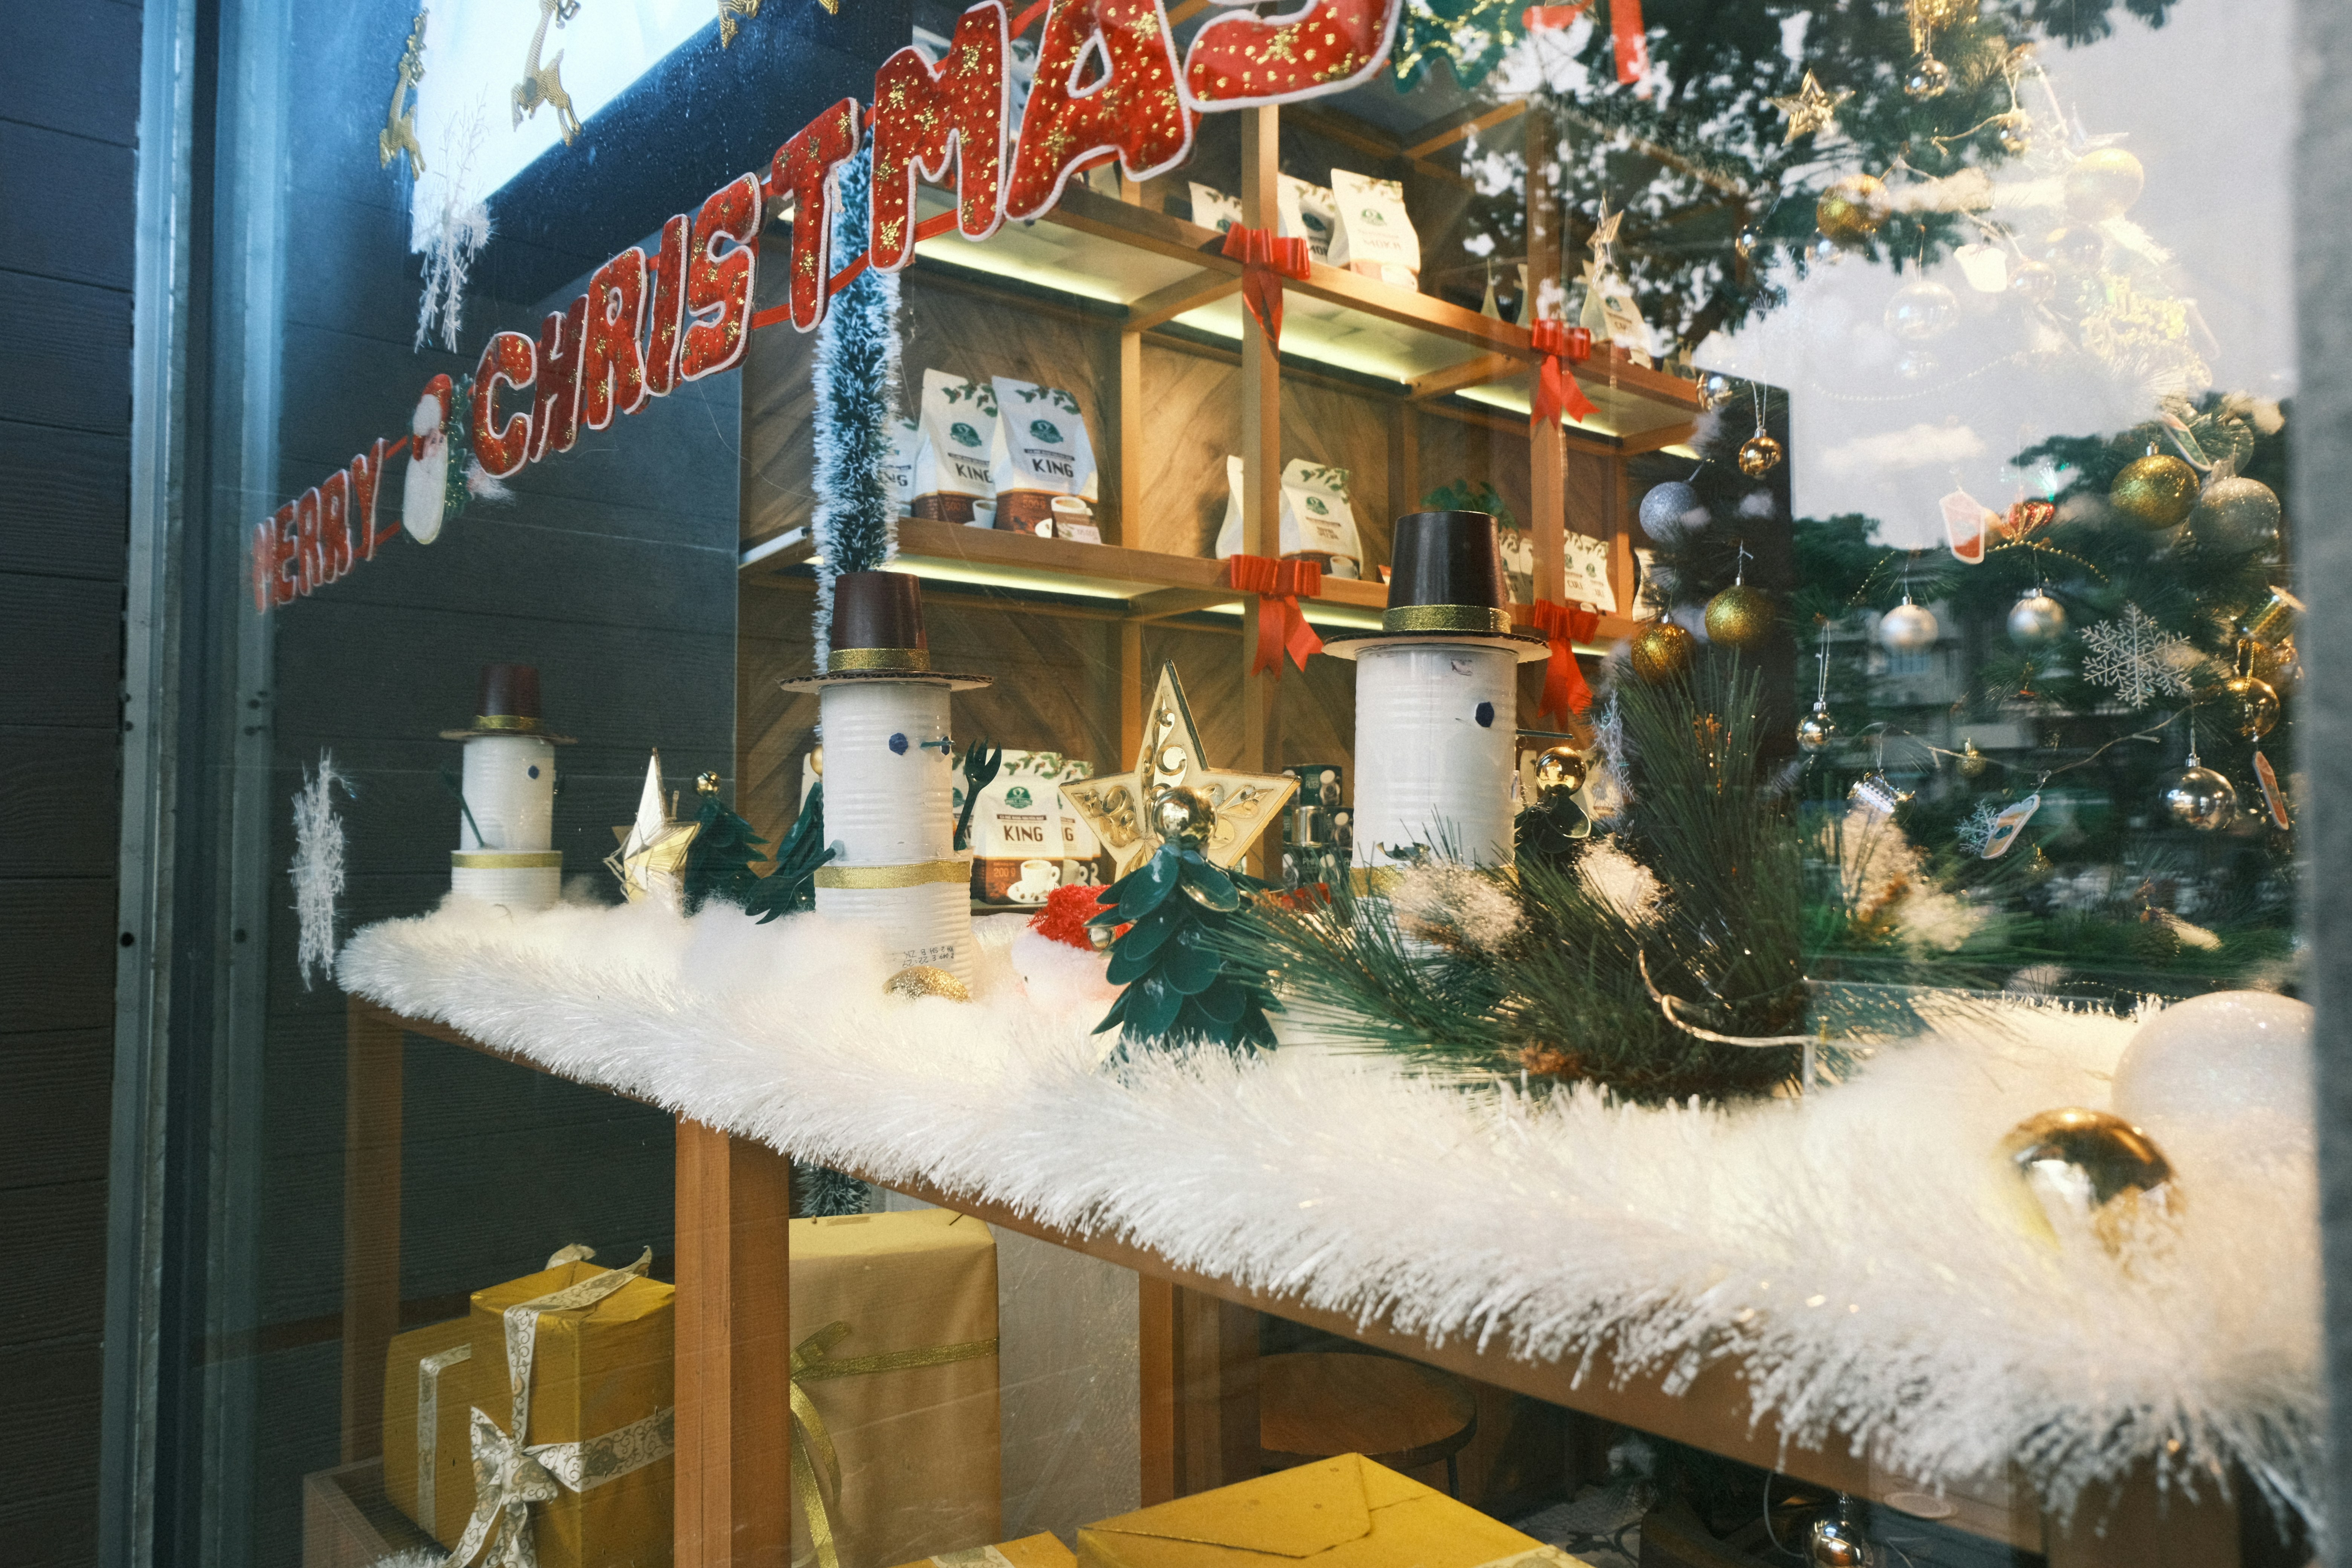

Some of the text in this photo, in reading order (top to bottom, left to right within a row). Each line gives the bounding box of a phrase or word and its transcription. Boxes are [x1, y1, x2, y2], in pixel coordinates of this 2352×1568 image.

[1032, 458, 1074, 478] KING
[1022, 500, 1040, 508] 500
[252, 436, 388, 615] MERRY
[1567, 580, 1583, 590] CULI
[1003, 825, 1043, 842] KING
[993, 867, 1009, 877] 200
